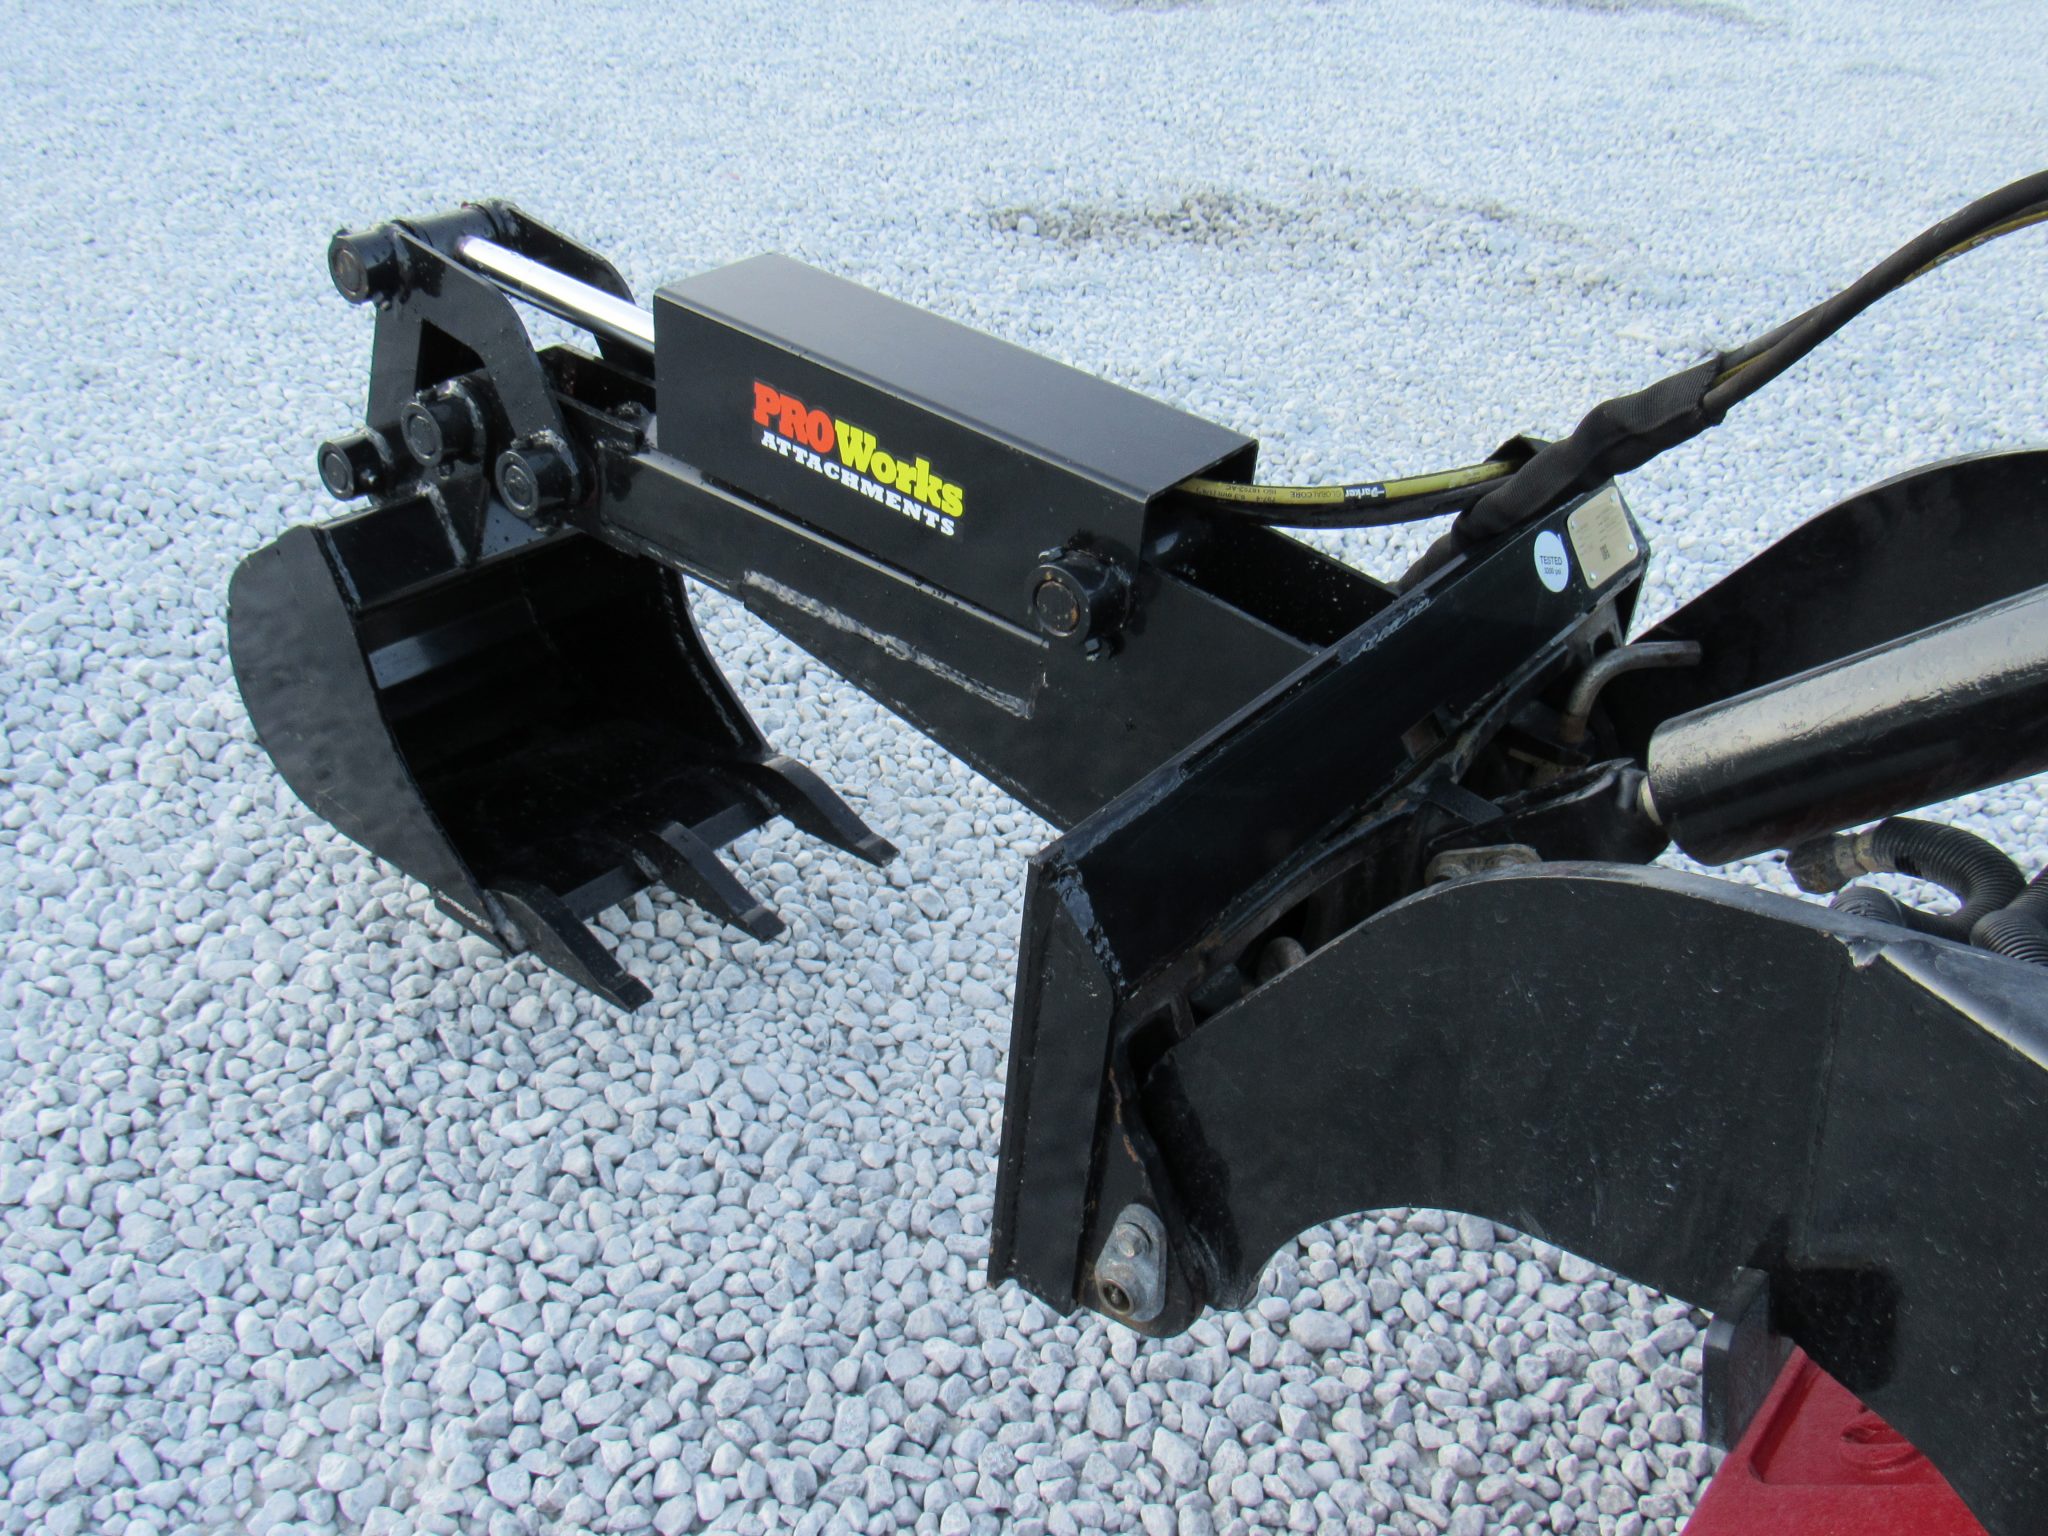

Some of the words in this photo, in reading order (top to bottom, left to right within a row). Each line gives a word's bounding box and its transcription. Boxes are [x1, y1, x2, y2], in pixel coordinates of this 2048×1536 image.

[761, 430, 955, 536] ATTACHMENTS
[1345, 486, 1379, 500] Parker
[1540, 555, 1563, 566] TESTED
